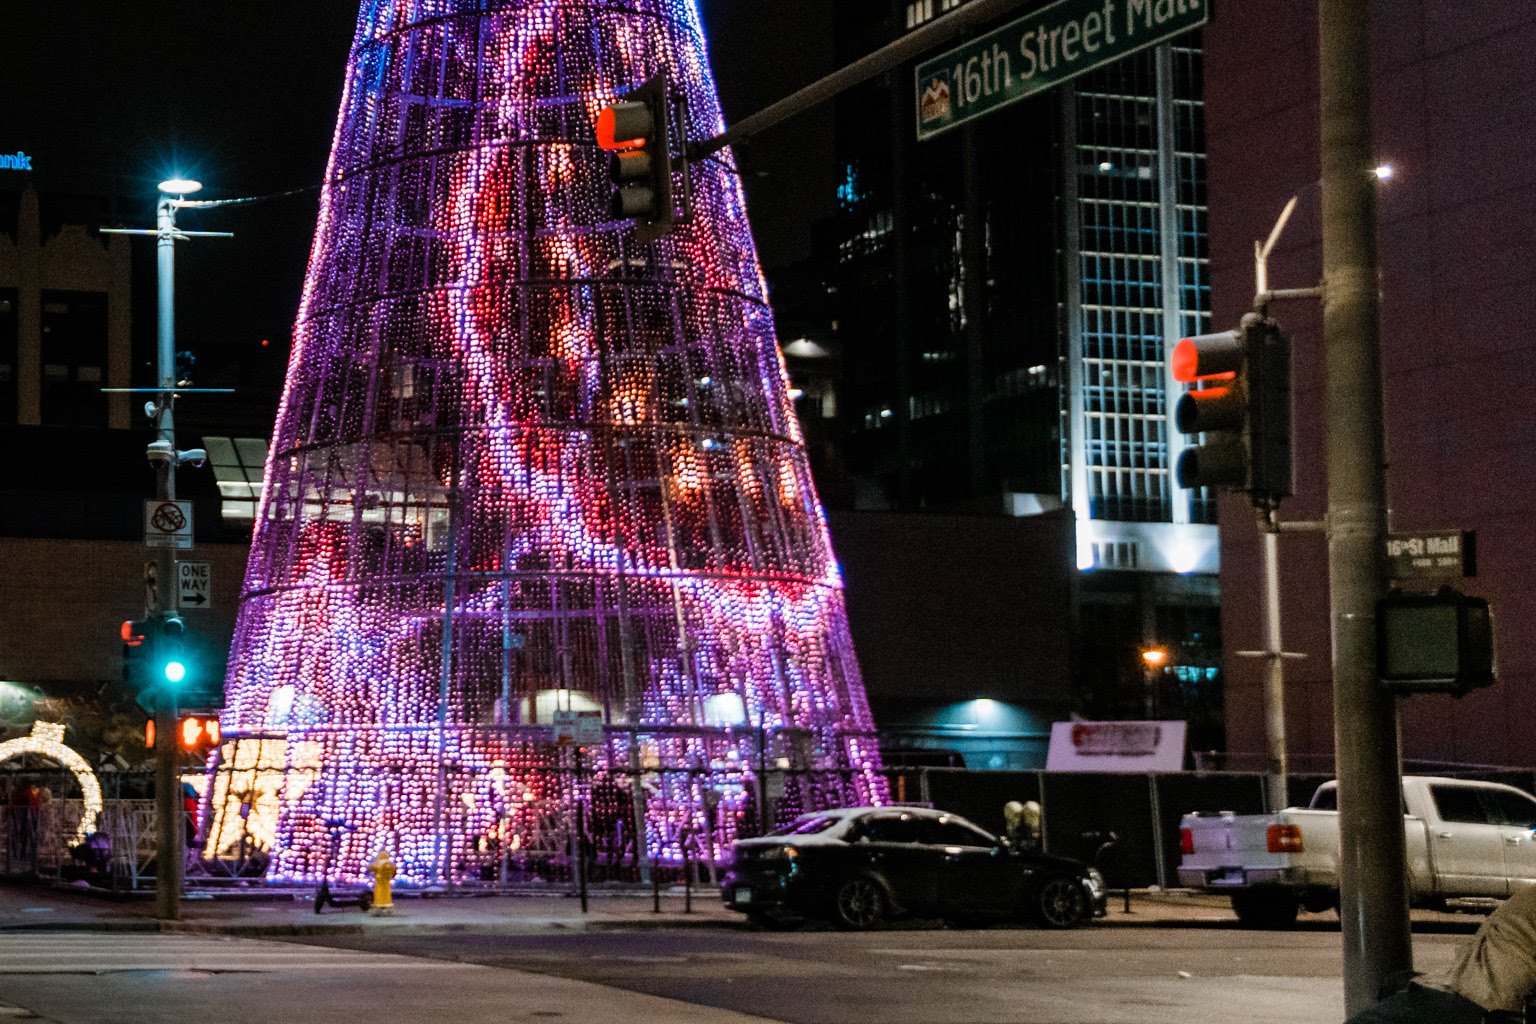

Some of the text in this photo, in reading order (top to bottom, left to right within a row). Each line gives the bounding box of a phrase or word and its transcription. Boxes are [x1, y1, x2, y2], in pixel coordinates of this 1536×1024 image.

[952, 42, 1012, 108] 16th
[182, 565, 208, 577] ONE
[182, 579, 208, 590] WAY
